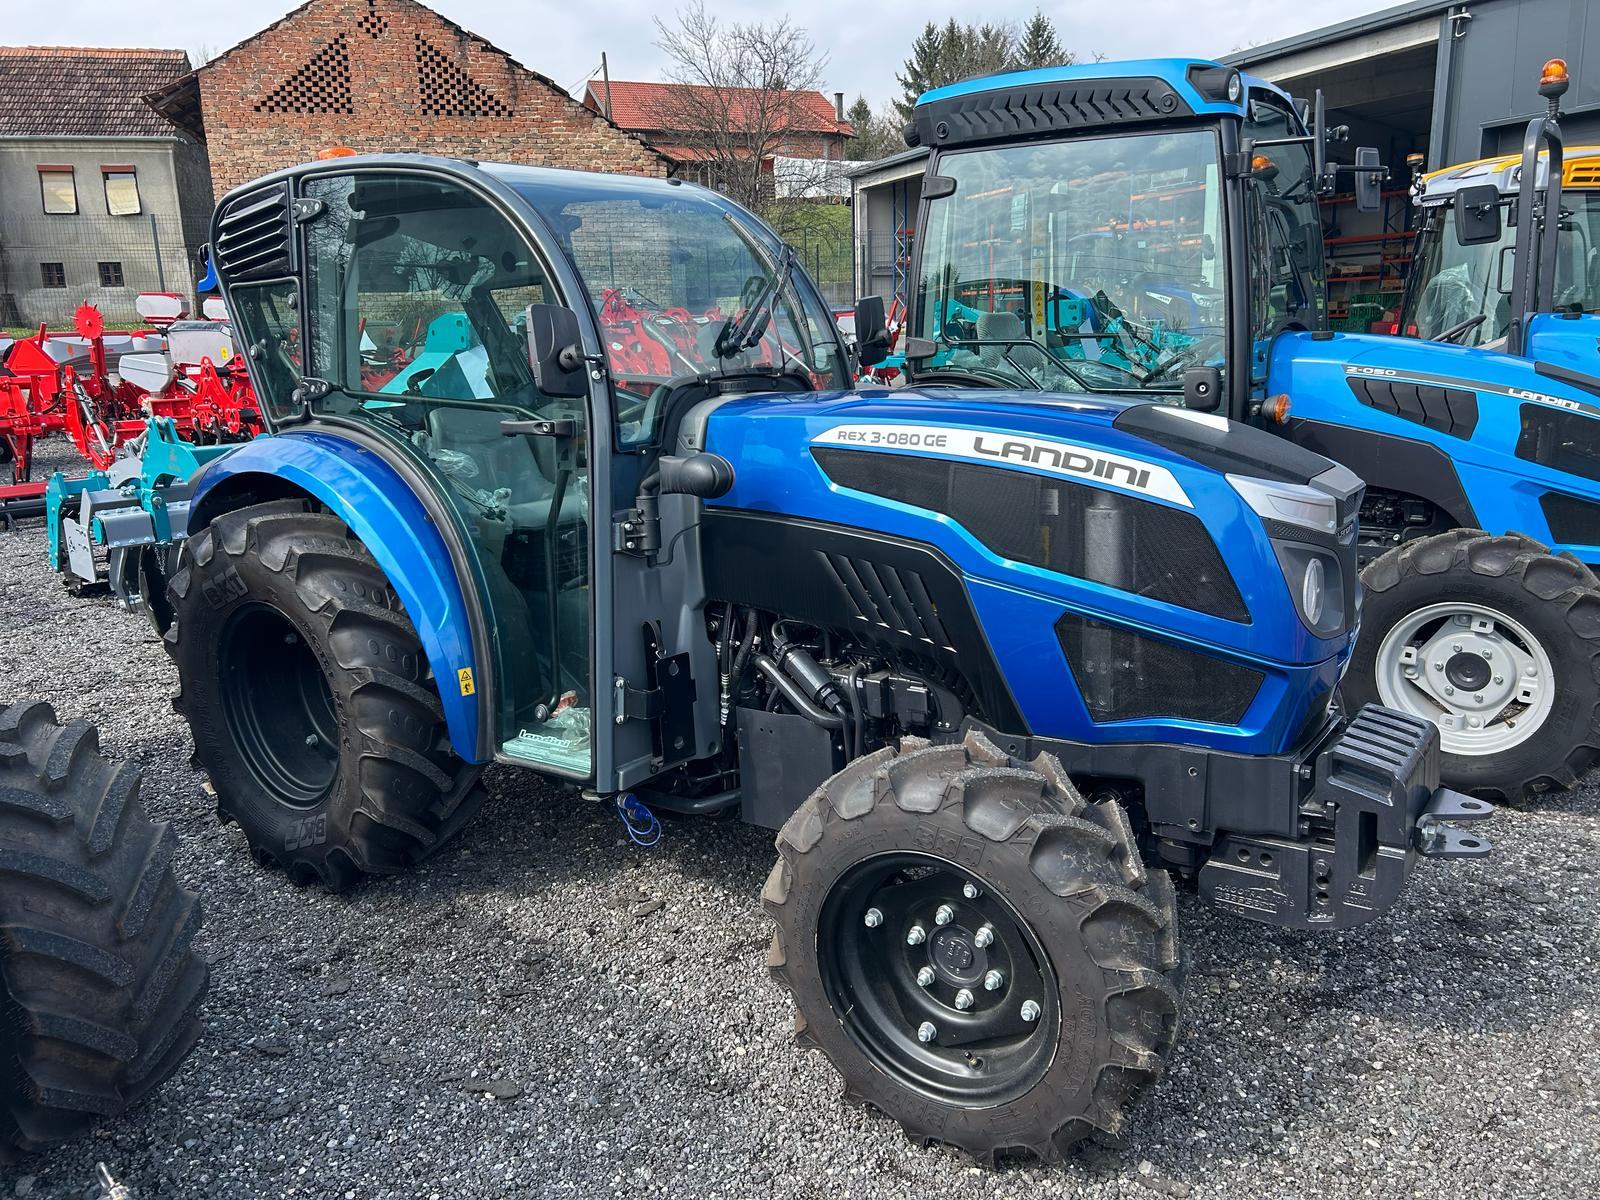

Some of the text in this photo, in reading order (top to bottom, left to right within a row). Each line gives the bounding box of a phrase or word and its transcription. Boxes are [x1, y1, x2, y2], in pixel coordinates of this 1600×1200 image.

[1508, 388, 1581, 410] LANDINI
[837, 430, 947, 448] REX 3-080 GE
[973, 437, 1151, 488] LANDINI
